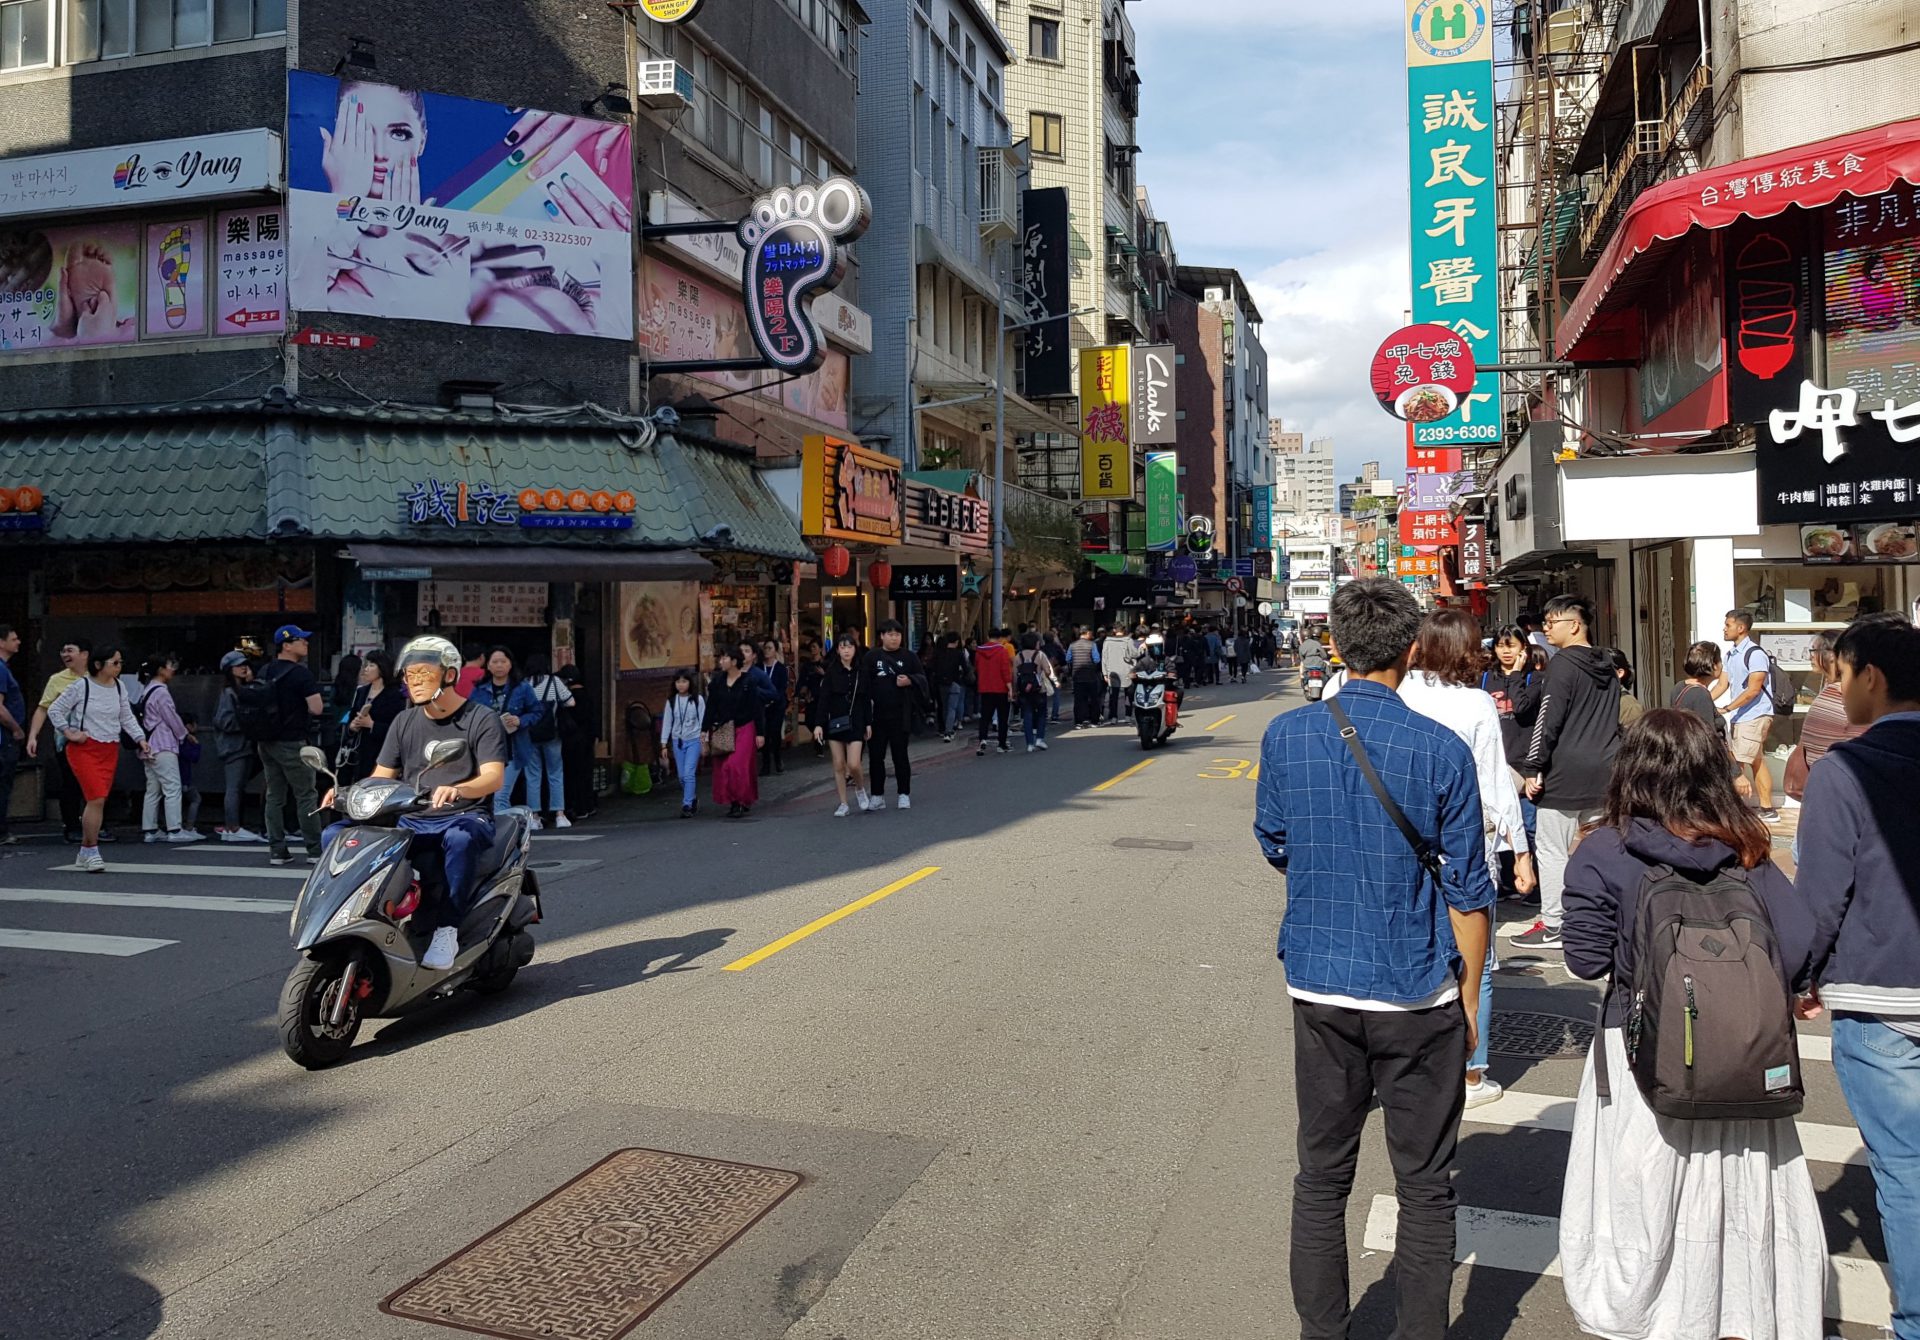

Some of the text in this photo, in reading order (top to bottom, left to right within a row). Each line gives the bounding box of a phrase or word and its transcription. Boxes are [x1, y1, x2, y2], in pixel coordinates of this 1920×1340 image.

[651, 2, 674, 11] TAIWAN
[176, 151, 242, 188] Yang
[1701, 153, 1867, 207] 台灣傳統美食
[227, 214, 280, 245] 樂陽
[391, 205, 449, 235] Yang
[524, 228, 592, 247] 02-33225307
[223, 249, 284, 262] massage
[779, 240, 819, 256] 마사지
[1420, 90, 1492, 422] 誠良牙醫
[223, 264, 284, 280] マッサージ
[227, 282, 277, 301] 마사지
[668, 301, 711, 329] massage
[1386, 339, 1461, 363] 呷七碗
[1137, 370, 1145, 421] ENGLAND
[1145, 353, 1170, 435] Clarks
[1419, 425, 1497, 442] 2393-6306
[1826, 482, 1851, 494] 油飯
[1859, 478, 1906, 491] 火雞肉飯
[1777, 490, 1815, 505] 牛肉麵
[1413, 514, 1448, 526] 上網卡
[1413, 528, 1450, 540] 預付卡
